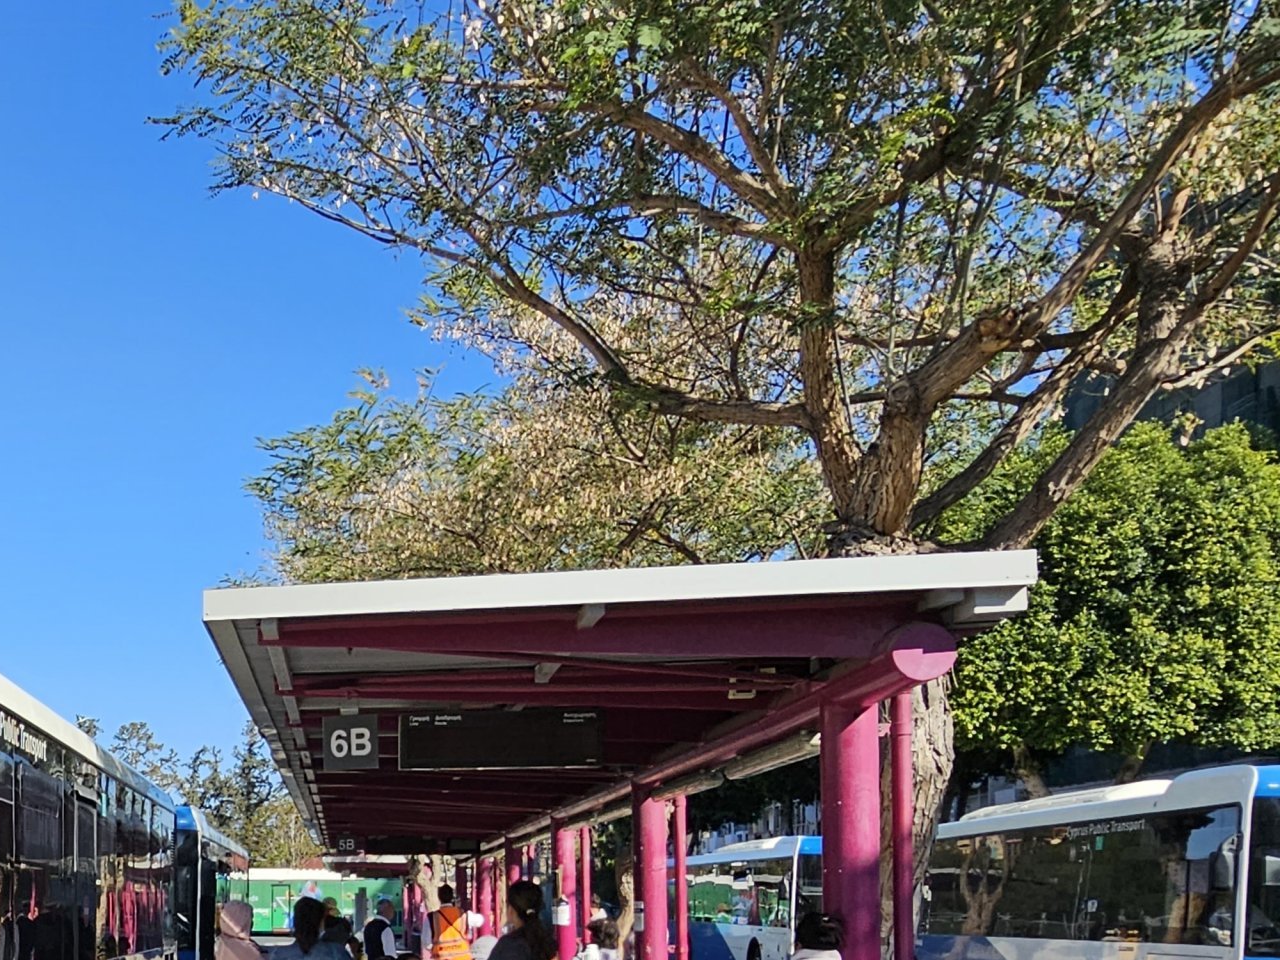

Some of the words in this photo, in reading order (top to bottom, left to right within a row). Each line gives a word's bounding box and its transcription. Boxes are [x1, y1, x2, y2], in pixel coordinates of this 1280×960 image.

[0, 711, 20, 748] Public
[19, 723, 47, 764] Transport
[330, 727, 372, 758] 6B
[338, 838, 355, 850] 5B
